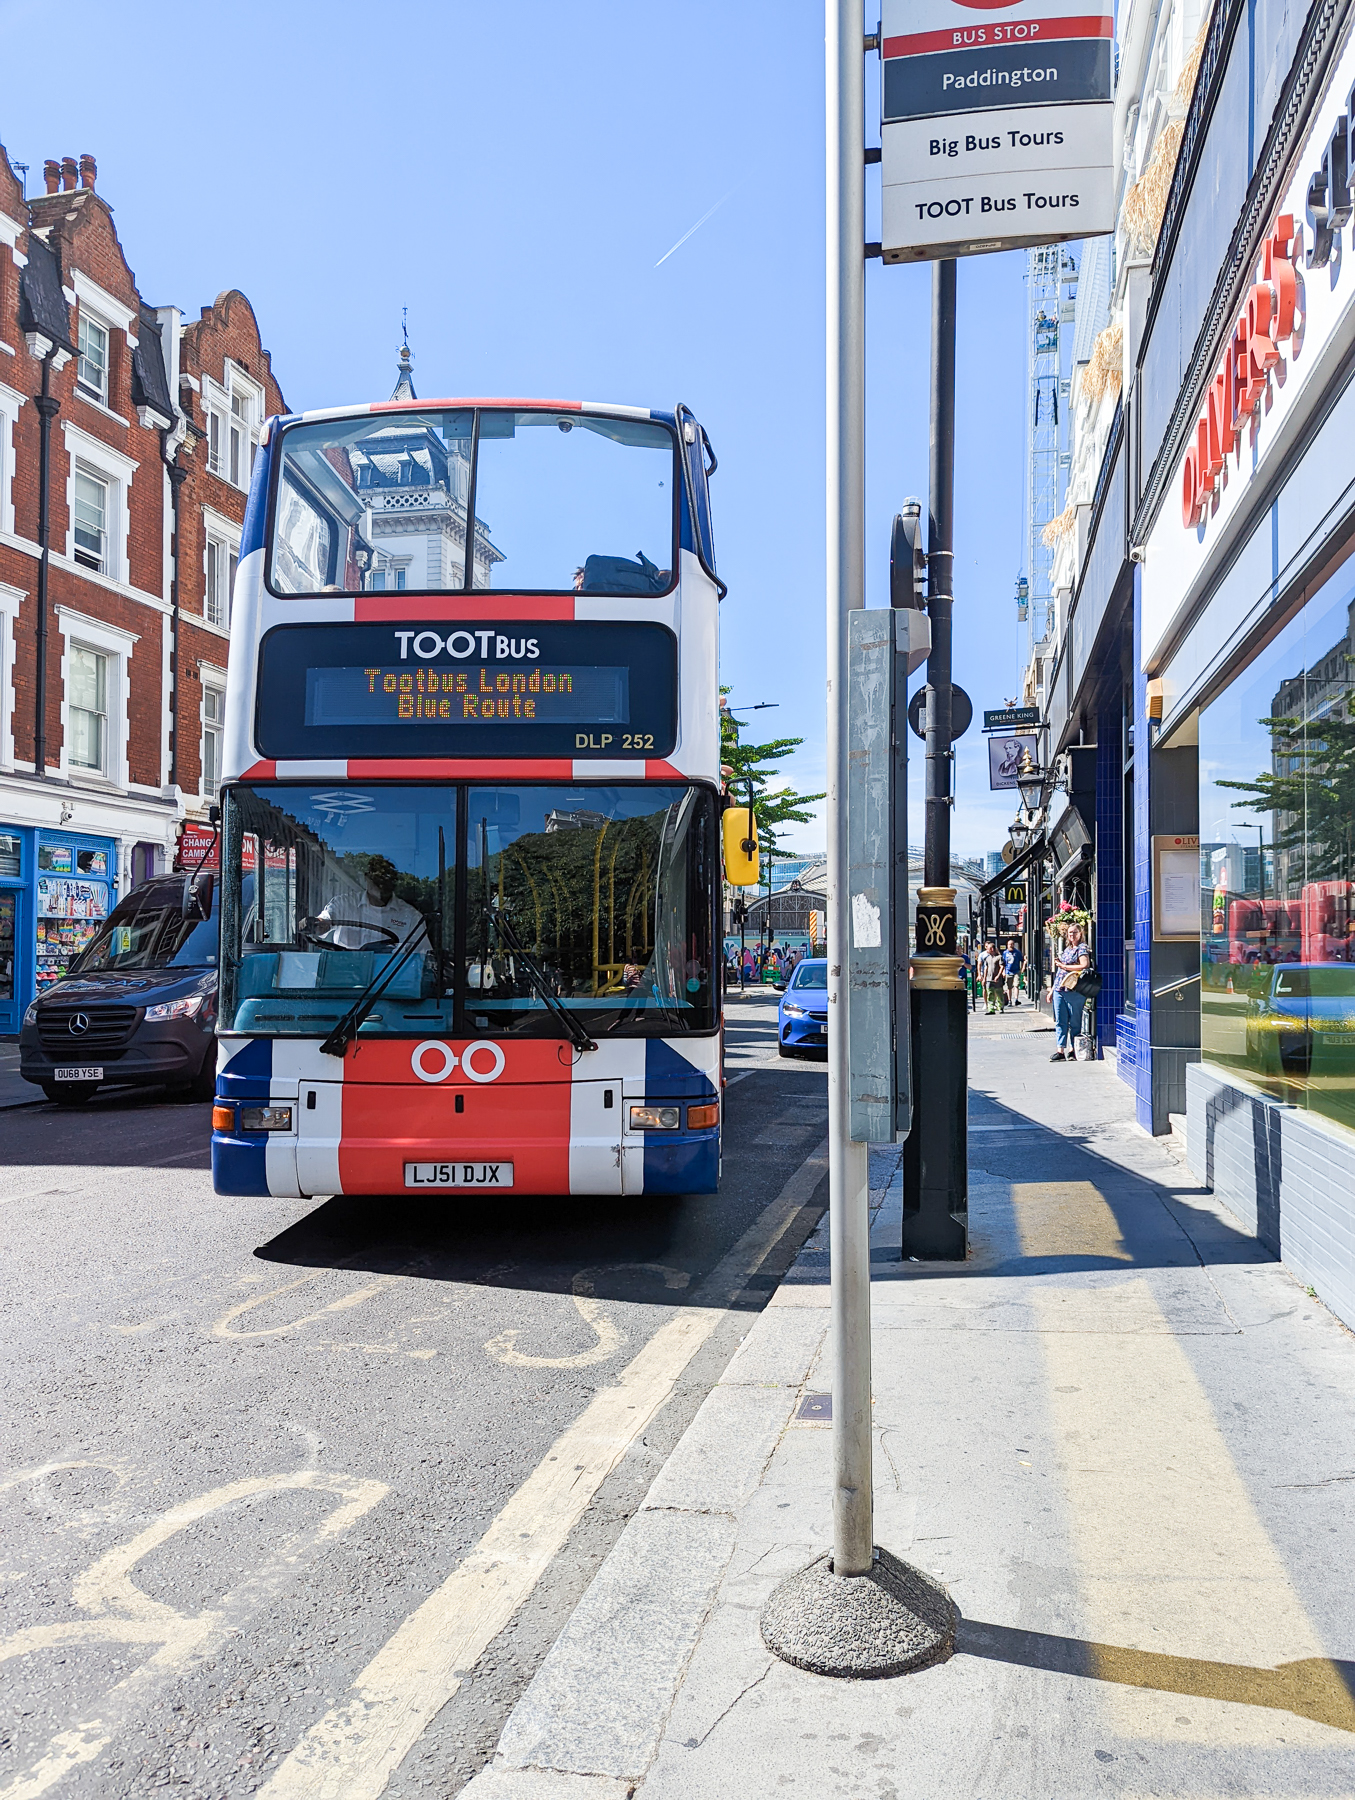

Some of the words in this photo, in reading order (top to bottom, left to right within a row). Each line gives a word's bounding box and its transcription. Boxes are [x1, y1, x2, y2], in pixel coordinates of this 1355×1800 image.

[953, 29, 986, 45] BUS
[994, 24, 1040, 41] STOP
[942, 67, 1058, 90] Paddington
[929, 138, 959, 157] Big
[965, 135, 1001, 152] Bus
[1007, 131, 1064, 148] Tours
[915, 198, 974, 220] TOOT
[981, 196, 1017, 213] Bus
[1023, 193, 1080, 210] Tours
[364, 668, 468, 693] Tootbus
[479, 668, 573, 693] London
[398, 694, 451, 718] Blue
[463, 694, 536, 718] Route
[989, 713, 1015, 721] GREENE
[1017, 711, 1034, 719] KING
[575, 734, 613, 749] DLP
[622, 734, 655, 749] 252
[182, 849, 215, 858] CAMBO
[58, 1069, 80, 1079] OU68
[82, 1068, 100, 1078] YSE
[412, 1165, 457, 1184] LJ51
[462, 1165, 500, 1184] DJX
